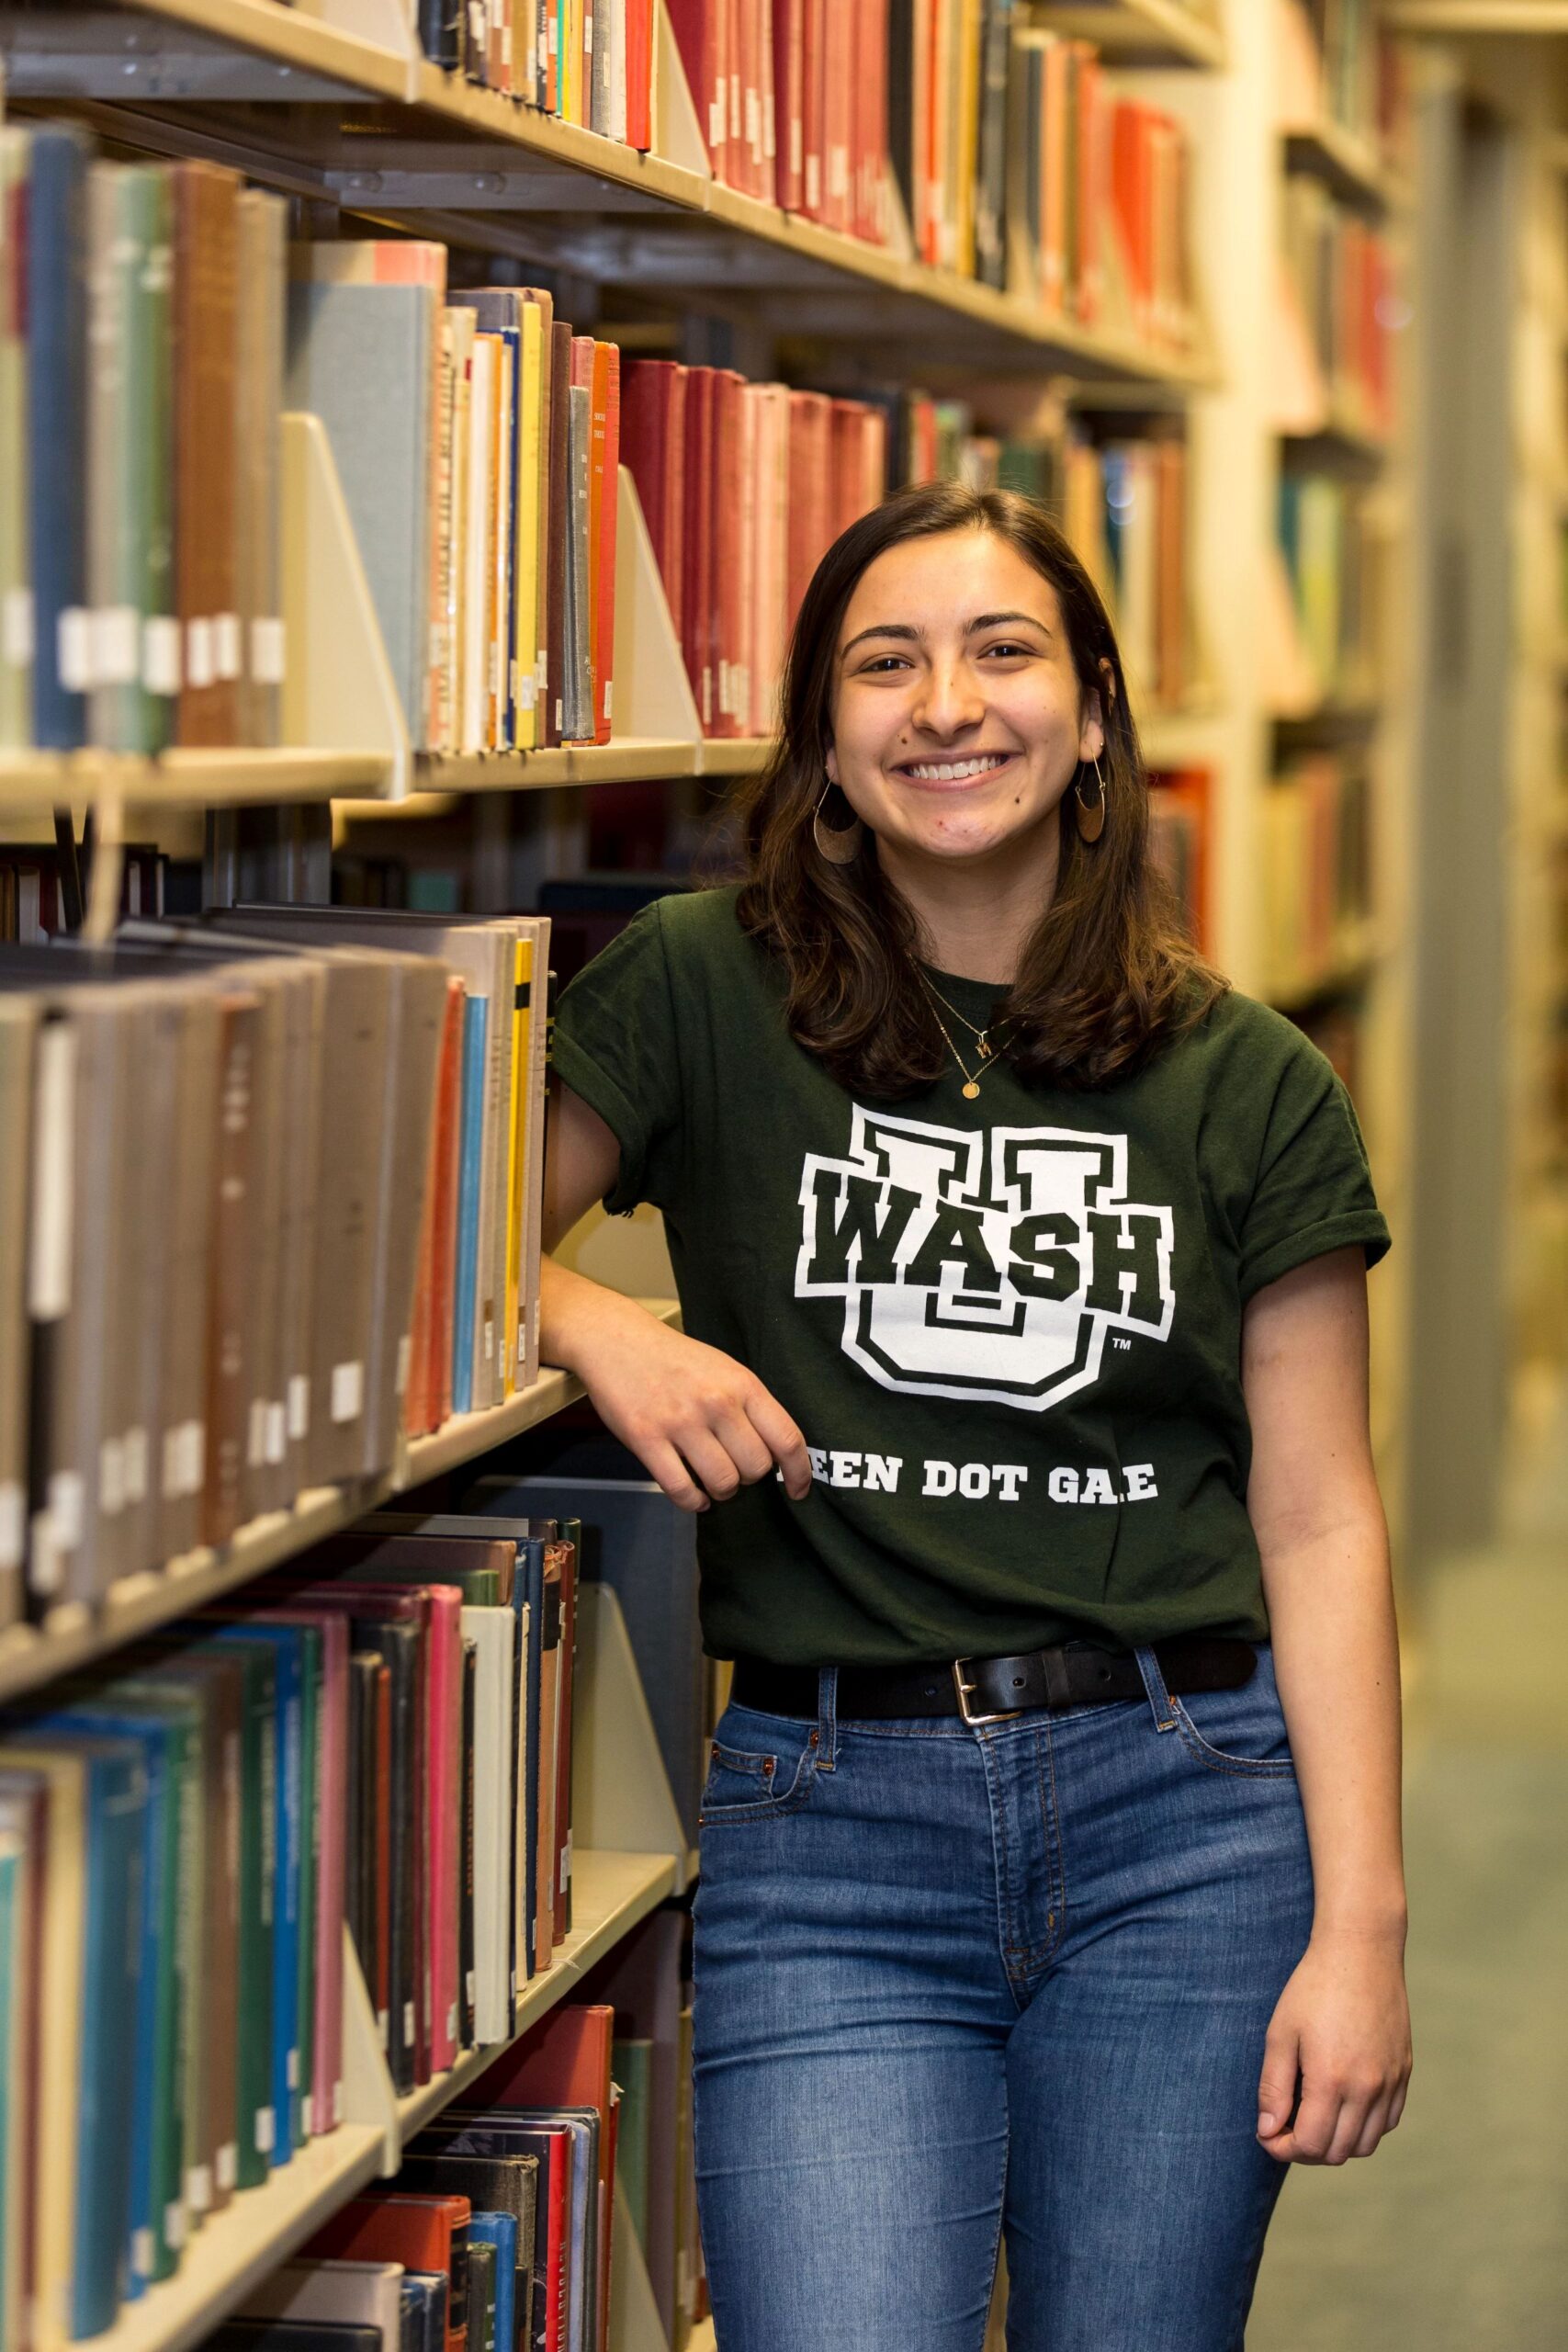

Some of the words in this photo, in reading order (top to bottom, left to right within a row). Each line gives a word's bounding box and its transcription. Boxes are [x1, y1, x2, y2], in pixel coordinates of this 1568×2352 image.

[795, 1156, 1175, 1340] WASH
[1112, 1338, 1132, 1351] TM
[776, 1446, 903, 1493] EEN
[921, 1460, 1028, 1501] DOT
[1048, 1463, 1158, 1504] GAE
